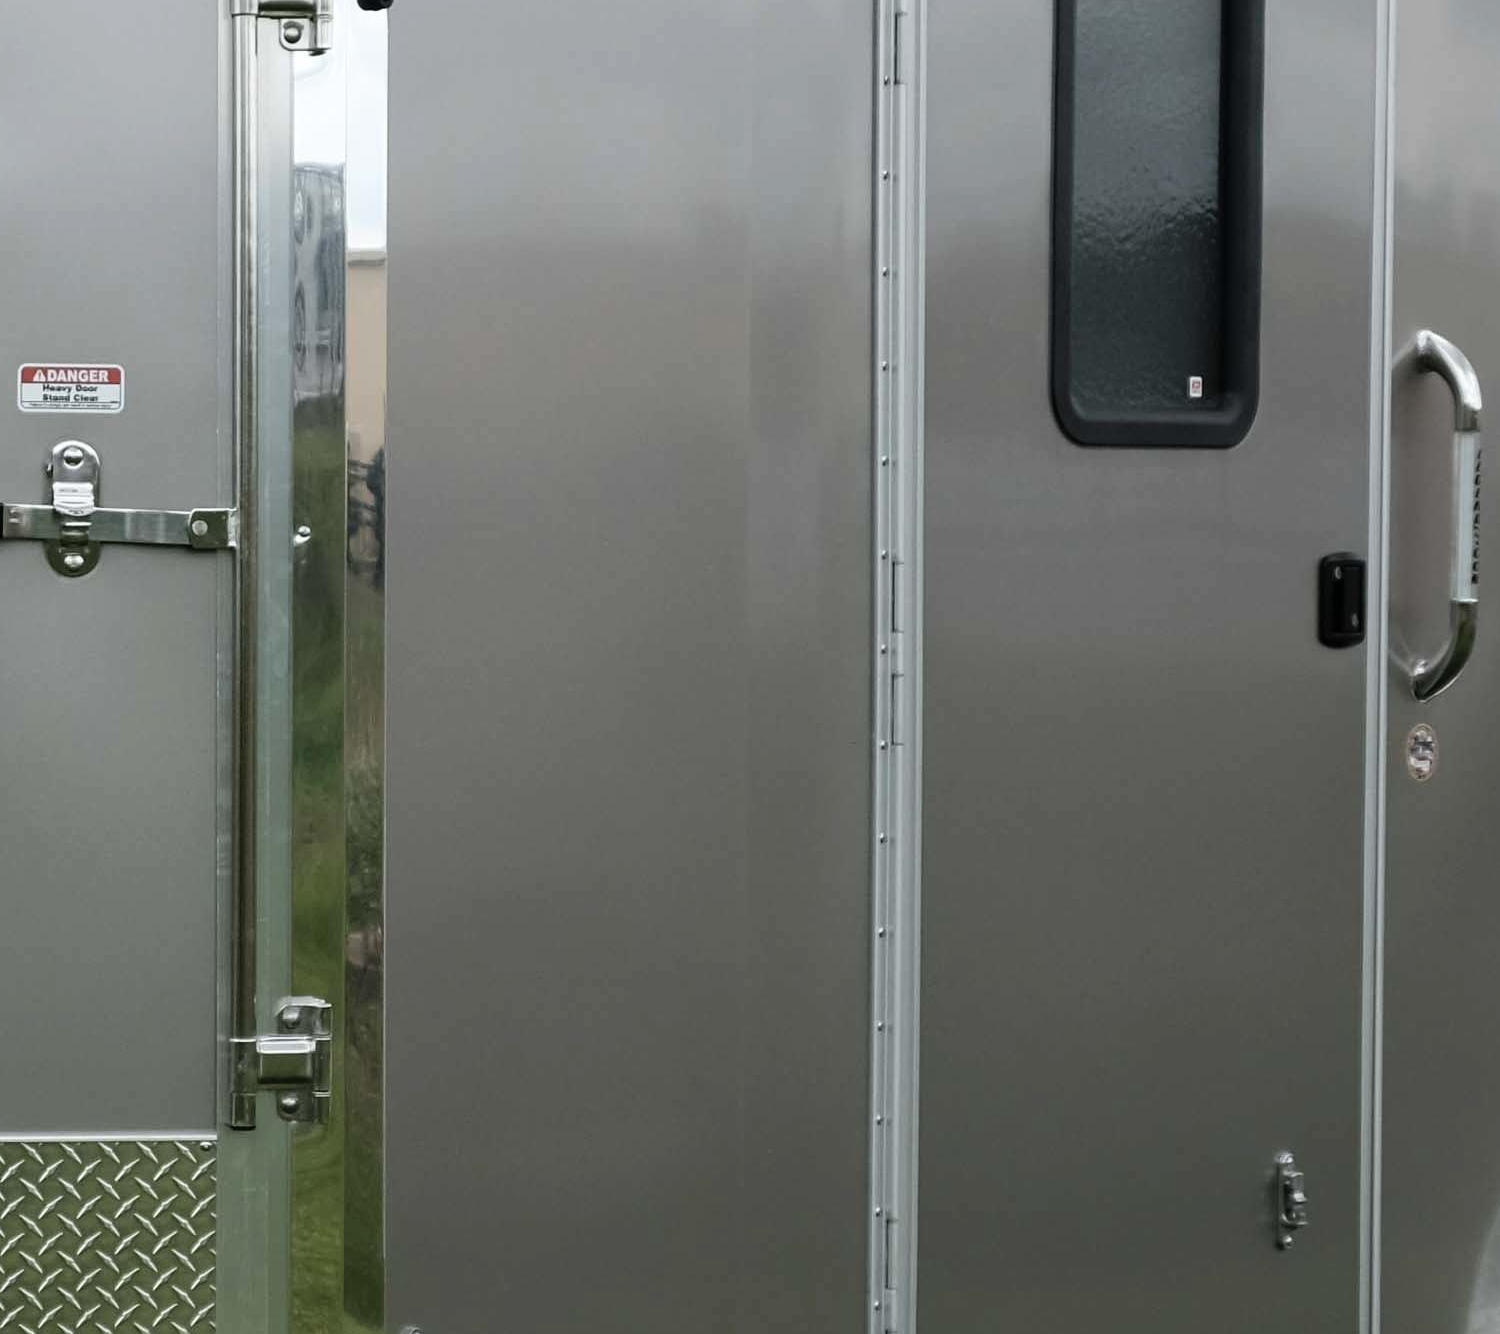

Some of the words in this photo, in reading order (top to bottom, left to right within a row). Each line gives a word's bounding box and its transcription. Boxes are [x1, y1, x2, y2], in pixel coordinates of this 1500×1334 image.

[47, 369, 109, 382] DANGER
[43, 384, 72, 393] Heavy
[75, 384, 98, 392] Door
[43, 393, 70, 402] Stand
[73, 394, 98, 402] Clear
